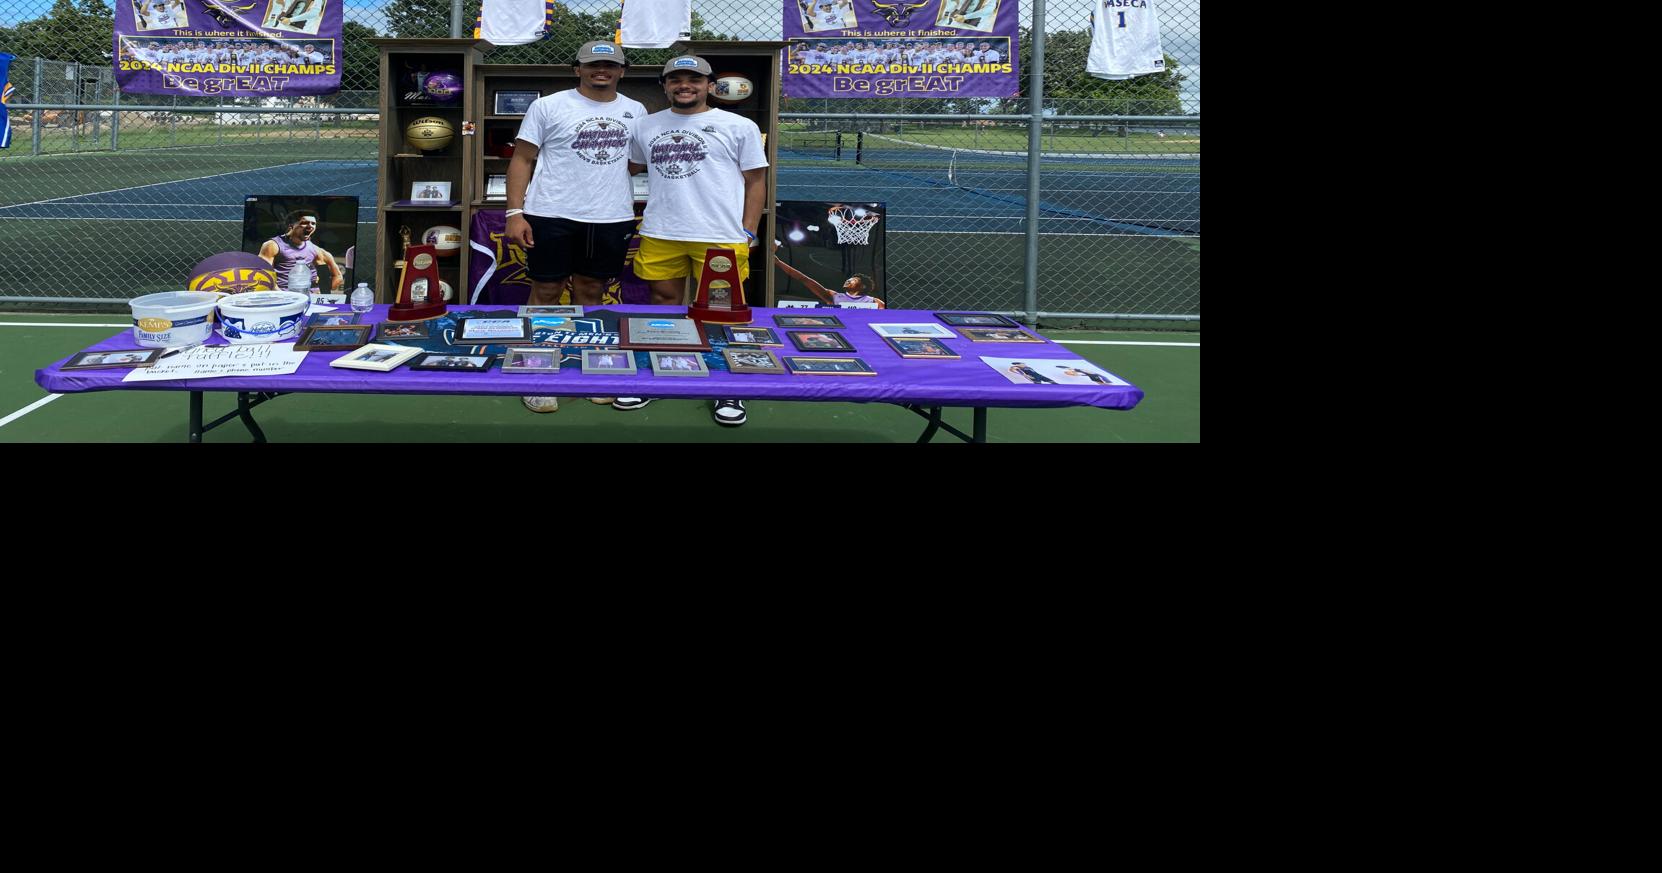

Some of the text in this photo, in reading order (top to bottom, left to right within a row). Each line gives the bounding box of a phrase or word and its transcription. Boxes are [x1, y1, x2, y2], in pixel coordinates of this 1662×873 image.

[1117, 11, 1126, 28] 1
[173, 29, 193, 37] This
[204, 30, 236, 38] where
[237, 30, 244, 38] it
[841, 29, 959, 37] This is where it finished.
[120, 60, 165, 71] 2024
[167, 62, 216, 73] NCAA
[218, 63, 247, 74] Div
[263, 63, 337, 75] CHAMPS
[788, 63, 833, 75] 2024
[837, 63, 887, 75] NCAA
[889, 63, 920, 74] Div
[935, 63, 1013, 74] CHAMPS
[163, 74, 290, 94] Be grEAT
[833, 75, 964, 96] Be grEAT
[577, 129, 626, 140] NATIONAL
[681, 129, 705, 145] DIVISION
[571, 138, 629, 150] CHAMPIONS
[652, 142, 702, 154] NATIONAL
[591, 153, 625, 165] BASKETBALL
[544, 333, 619, 345] EIGHT
